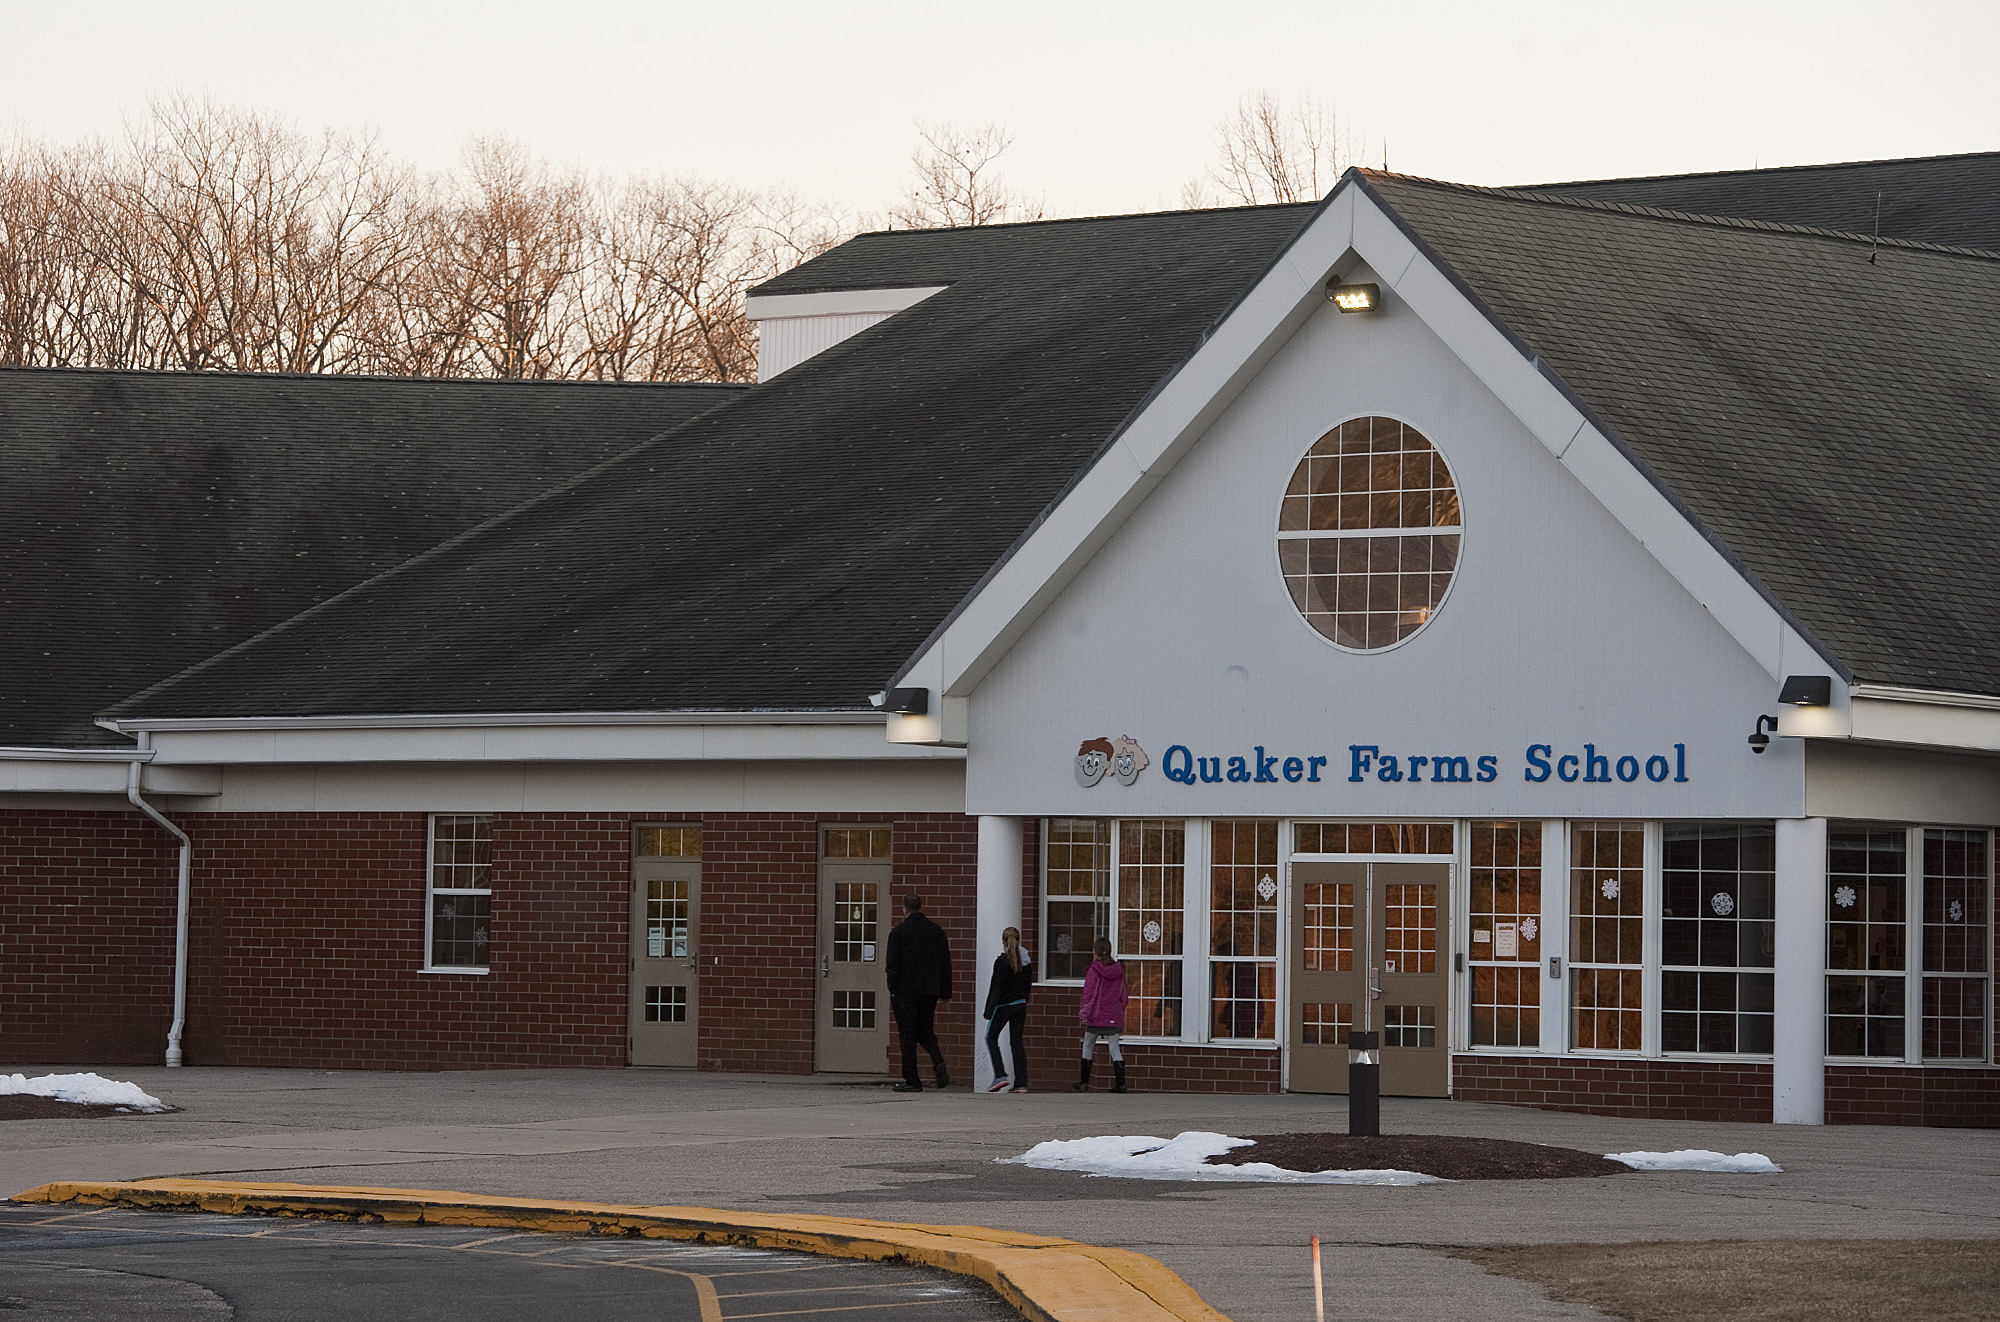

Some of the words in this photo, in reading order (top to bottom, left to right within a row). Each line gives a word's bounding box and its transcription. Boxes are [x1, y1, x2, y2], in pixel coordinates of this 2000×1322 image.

[1162, 744, 1327, 785] Quaker
[1347, 744, 1498, 783] Farms
[1525, 743, 1688, 783] School
